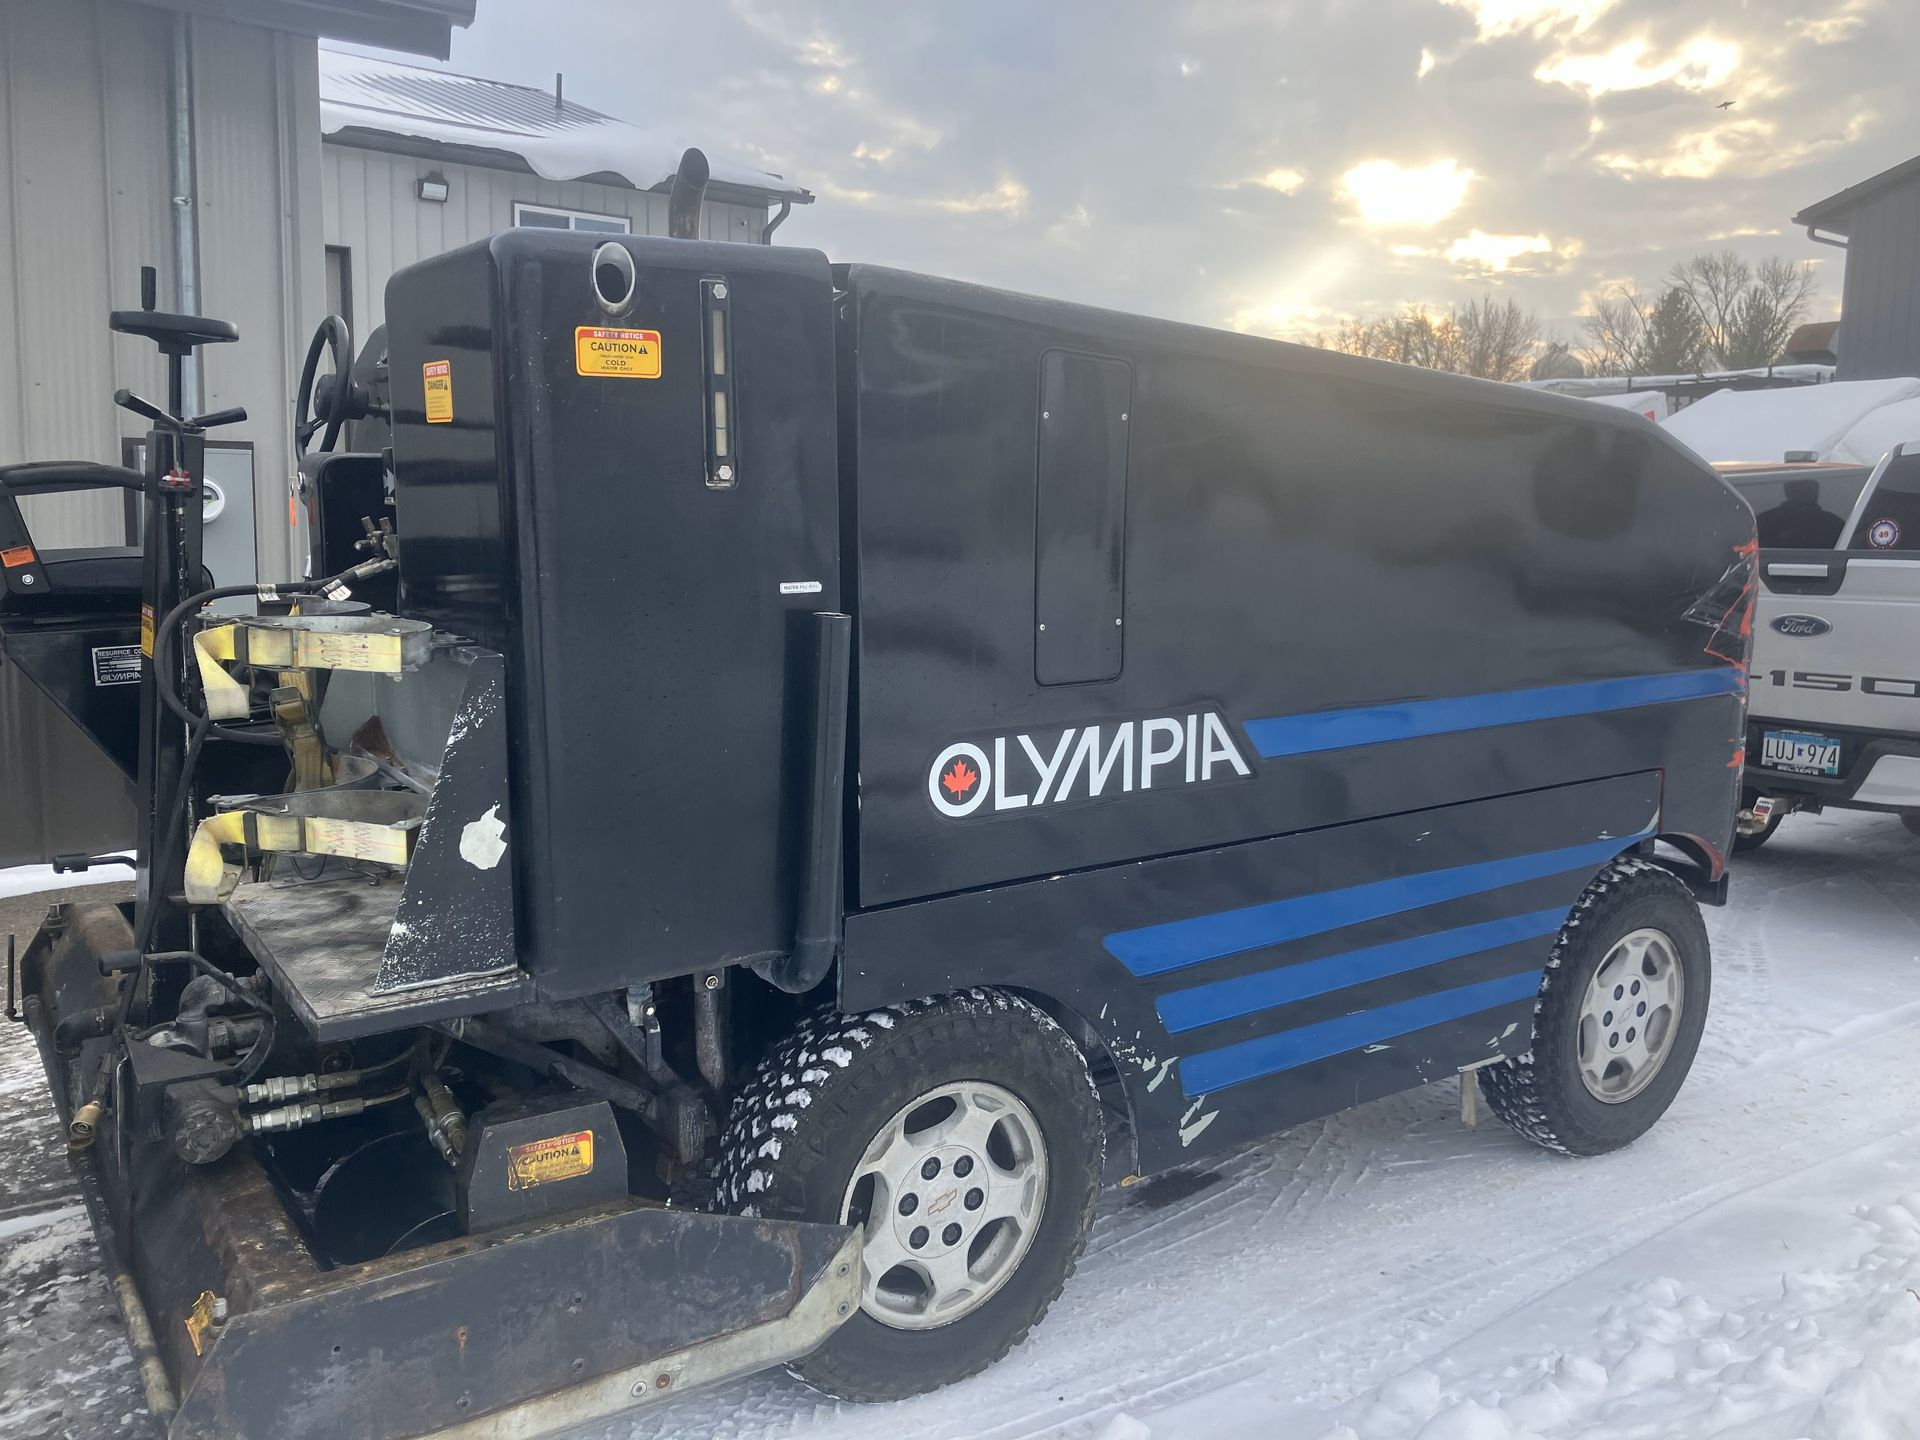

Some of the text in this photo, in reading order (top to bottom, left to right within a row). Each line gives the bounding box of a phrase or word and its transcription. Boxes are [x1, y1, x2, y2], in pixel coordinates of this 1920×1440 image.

[593, 330, 644, 340] SAFETY NOTICE
[590, 341, 637, 353] CAUTION
[1780, 616, 1816, 635] Ford
[101, 672, 141, 681] OLYMPIA
[1765, 738, 1837, 767] LUJ 974
[928, 712, 1251, 818] OLYMPIA
